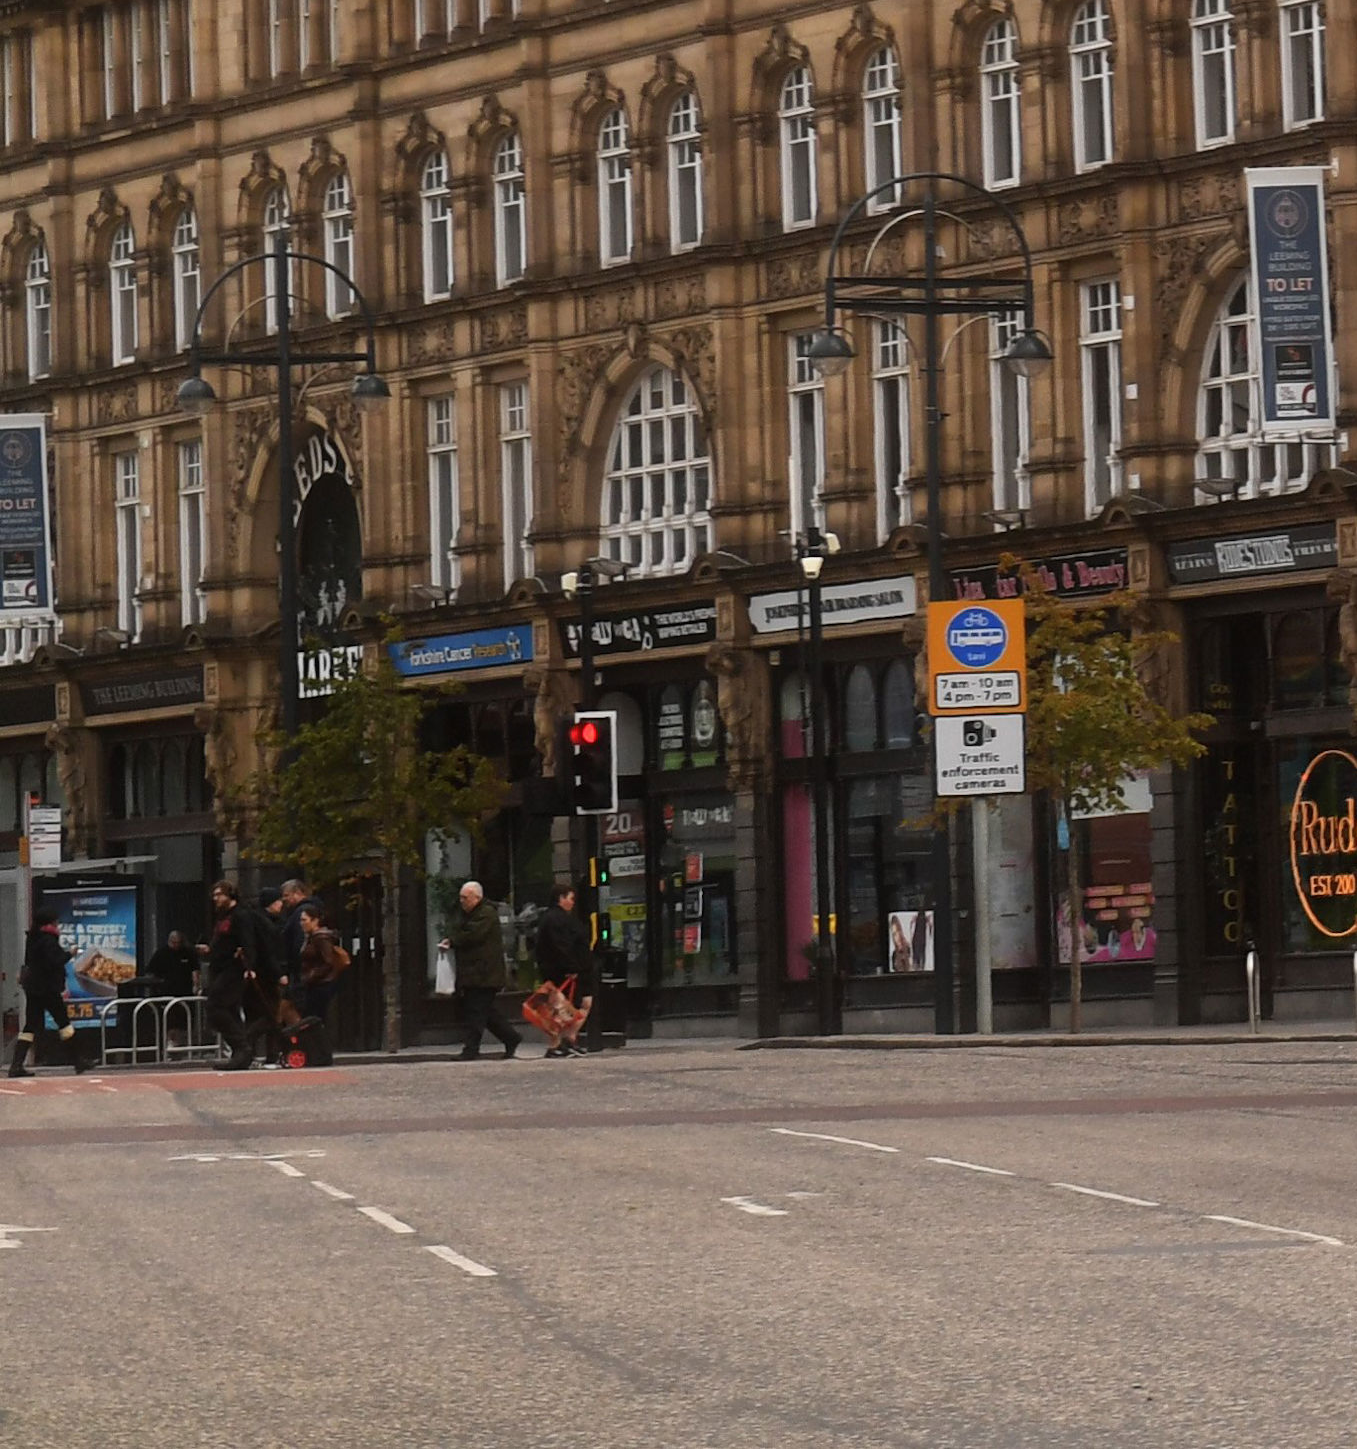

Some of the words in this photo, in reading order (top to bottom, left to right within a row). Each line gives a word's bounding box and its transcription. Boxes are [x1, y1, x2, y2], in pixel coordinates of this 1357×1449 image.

[1266, 278, 1287, 292] TO
[1290, 277, 1314, 291] LET
[17, 498, 36, 510] LET
[445, 647, 472, 661] Cancer
[967, 651, 986, 661] taxi
[941, 679, 948, 688] 7
[951, 681, 969, 689] am
[979, 677, 993, 688] 10
[996, 679, 1013, 687] am
[944, 692, 952, 702] 4
[955, 692, 974, 704] pm
[984, 691, 990, 700] 7
[992, 690, 1012, 702] pm
[960, 753, 1000, 763] Traffic
[942, 765, 1019, 778] enforcement
[955, 779, 1006, 789] cameras
[606, 813, 632, 835] 20
[1335, 875, 1357, 895] 200
